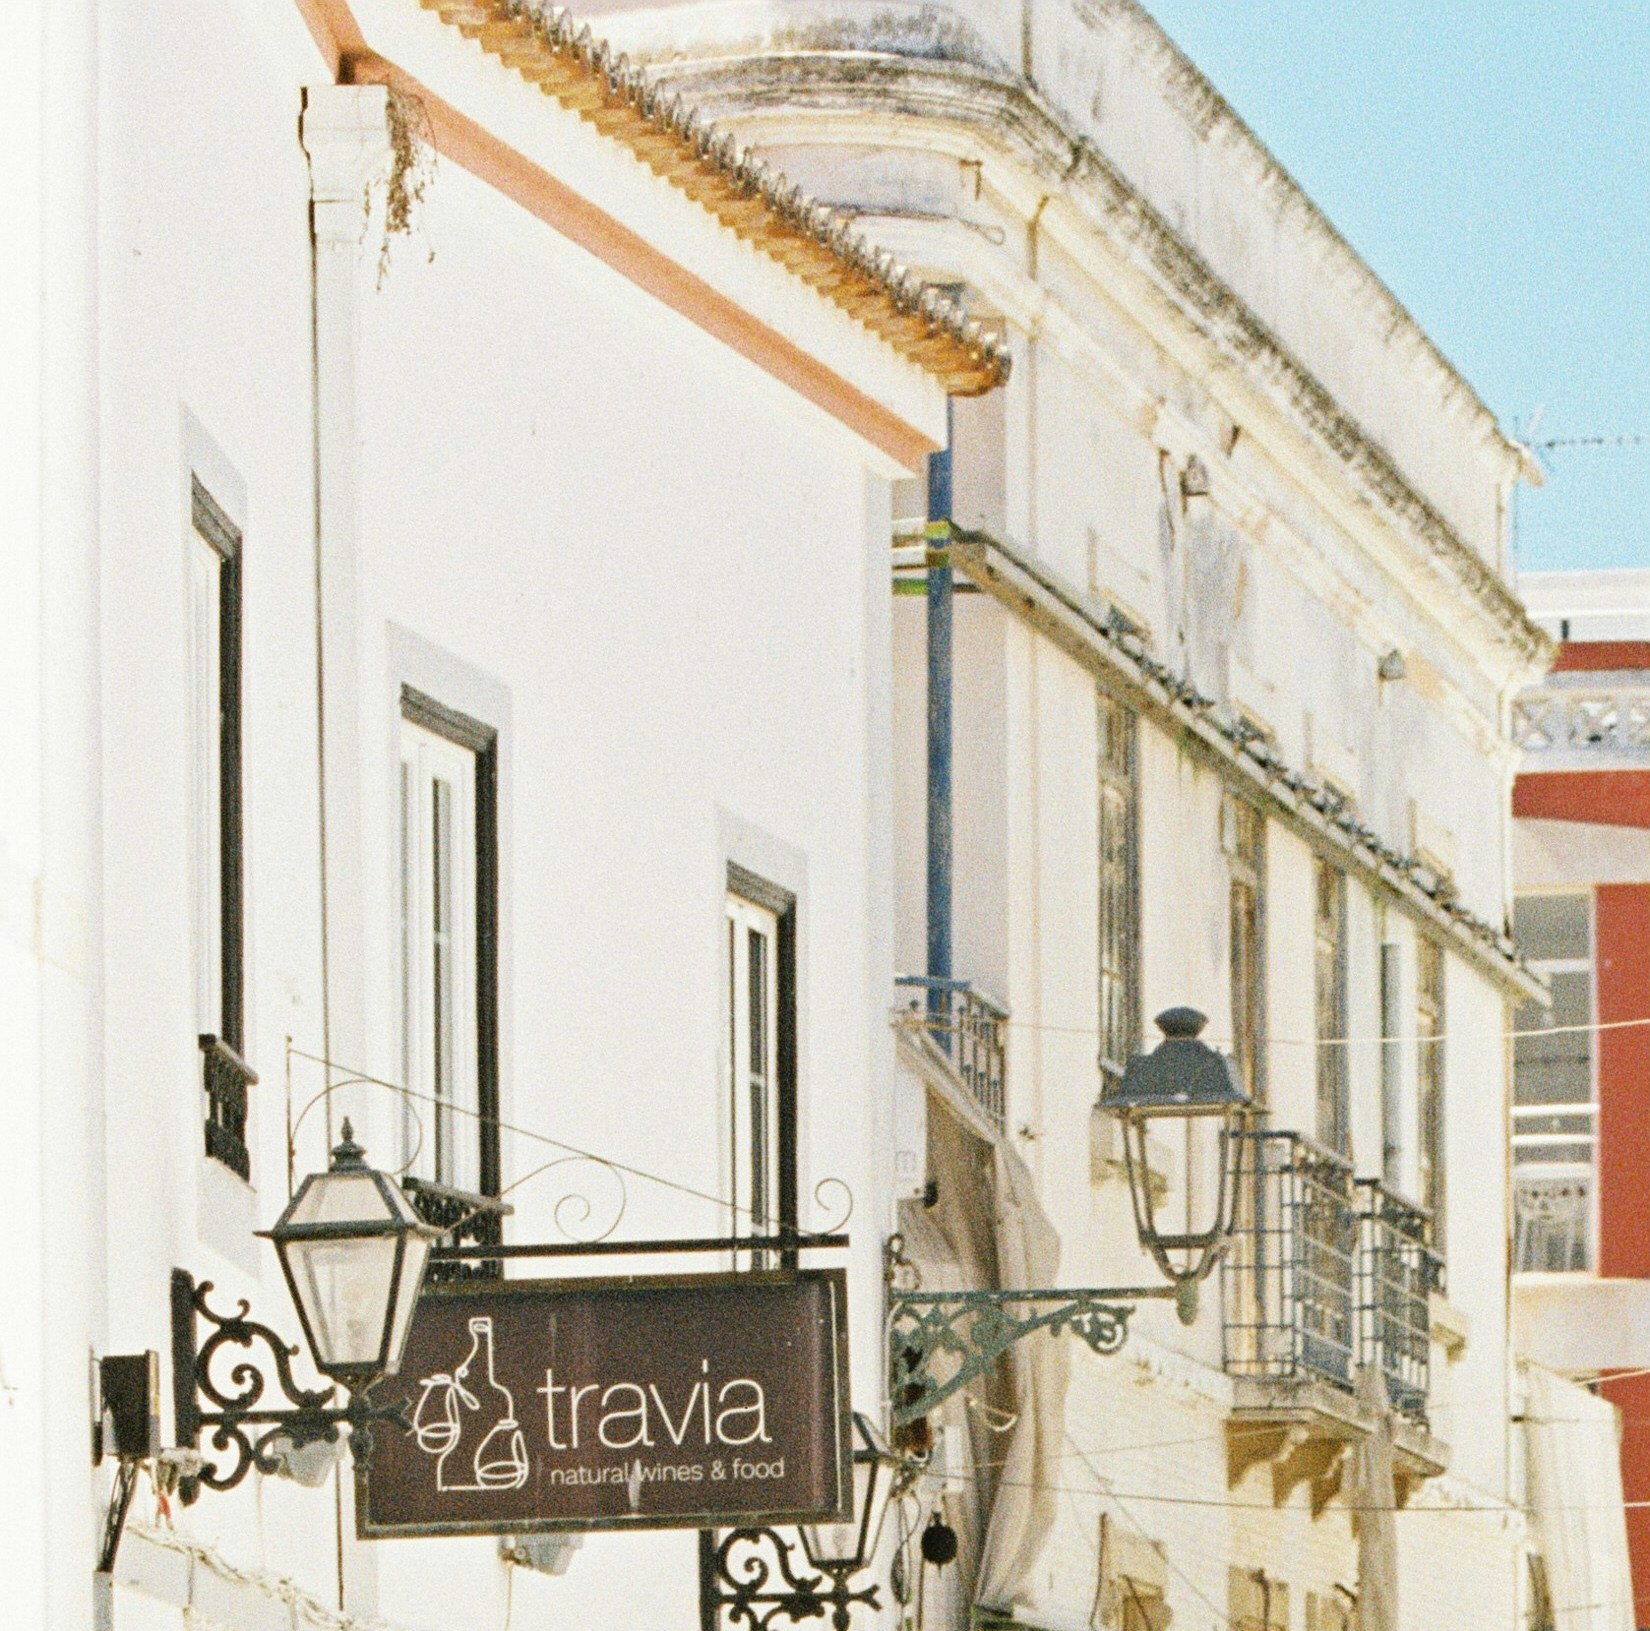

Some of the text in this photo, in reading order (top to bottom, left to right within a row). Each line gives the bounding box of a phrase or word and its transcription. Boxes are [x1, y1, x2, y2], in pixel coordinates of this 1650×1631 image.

[537, 1358, 771, 1449] travia
[550, 1457, 786, 1485] natural wines & food
